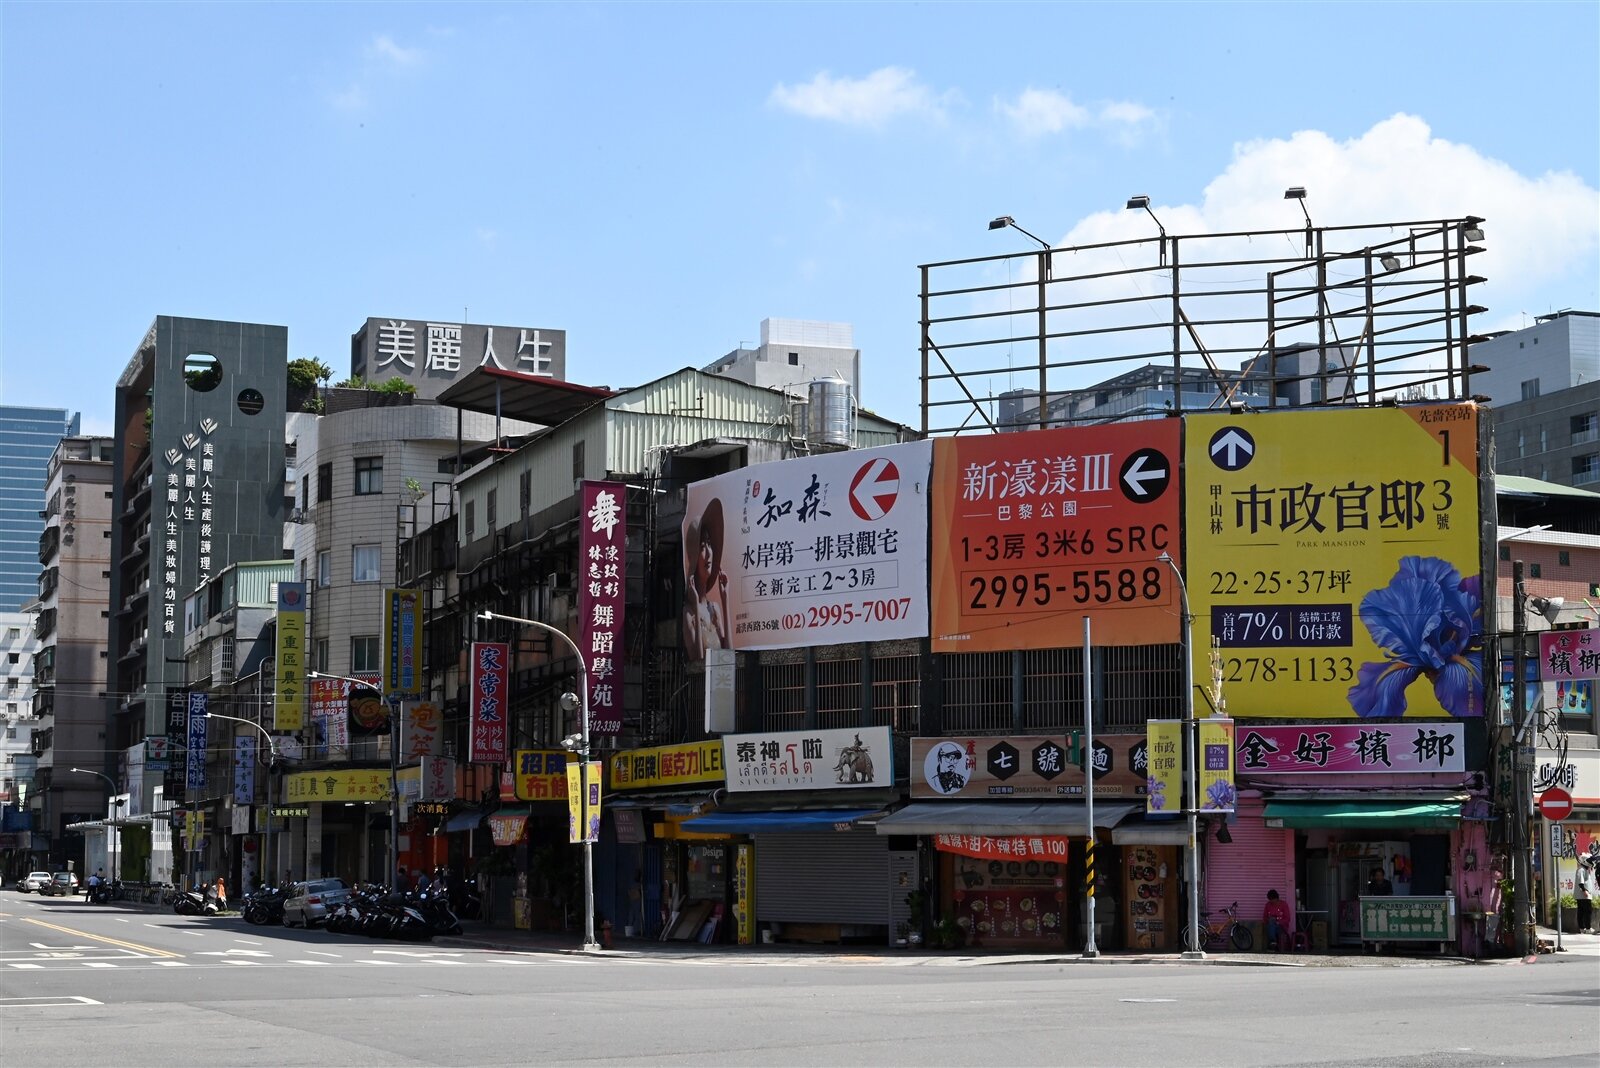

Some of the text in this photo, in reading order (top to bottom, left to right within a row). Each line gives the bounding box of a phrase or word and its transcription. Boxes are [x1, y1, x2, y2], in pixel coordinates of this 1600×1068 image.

[378, 320, 553, 377] 美麗人生
[1438, 429, 1450, 466] 1
[183, 457, 196, 521] 美麗人生
[756, 473, 832, 528] 知森
[1230, 478, 1425, 535] 市政官邸
[587, 490, 621, 540] 舞
[998, 500, 1077, 521] 巴黎公園
[1210, 484, 1223, 535] 甲山林
[164, 473, 179, 633] 美麗人生美妝婦幼百貨
[741, 528, 899, 570] 水岸第一排景觀宅
[961, 523, 1169, 562] 1-3房 3米6 SRC
[969, 566, 1161, 609] 2995-5588
[1222, 612, 1235, 641] 首付
[1237, 611, 1283, 641] 7%
[1299, 611, 1341, 623] 結構工程
[1299, 623, 1342, 641] 0付款
[591, 603, 614, 707] 舞蹈學苑
[1559, 633, 1592, 647] 金好
[281, 618, 300, 702] 三重區農會
[1549, 649, 1600, 676] 檳榔
[479, 646, 502, 723] 家常菜
[191, 693, 206, 734] 承雨
[475, 725, 488, 751] 炒飯
[491, 725, 503, 751] 炒麵
[965, 739, 977, 772] 蘆洲
[1154, 741, 1175, 754] 市政
[1237, 728, 1456, 768] 金好檳榔
[430, 758, 449, 798] 電池
[634, 754, 656, 780] 招牌
[661, 750, 698, 777] 壓克力
[703, 748, 724, 772] LE
[1154, 757, 1175, 770] 官邸
[739, 777, 778, 786] SINCE
